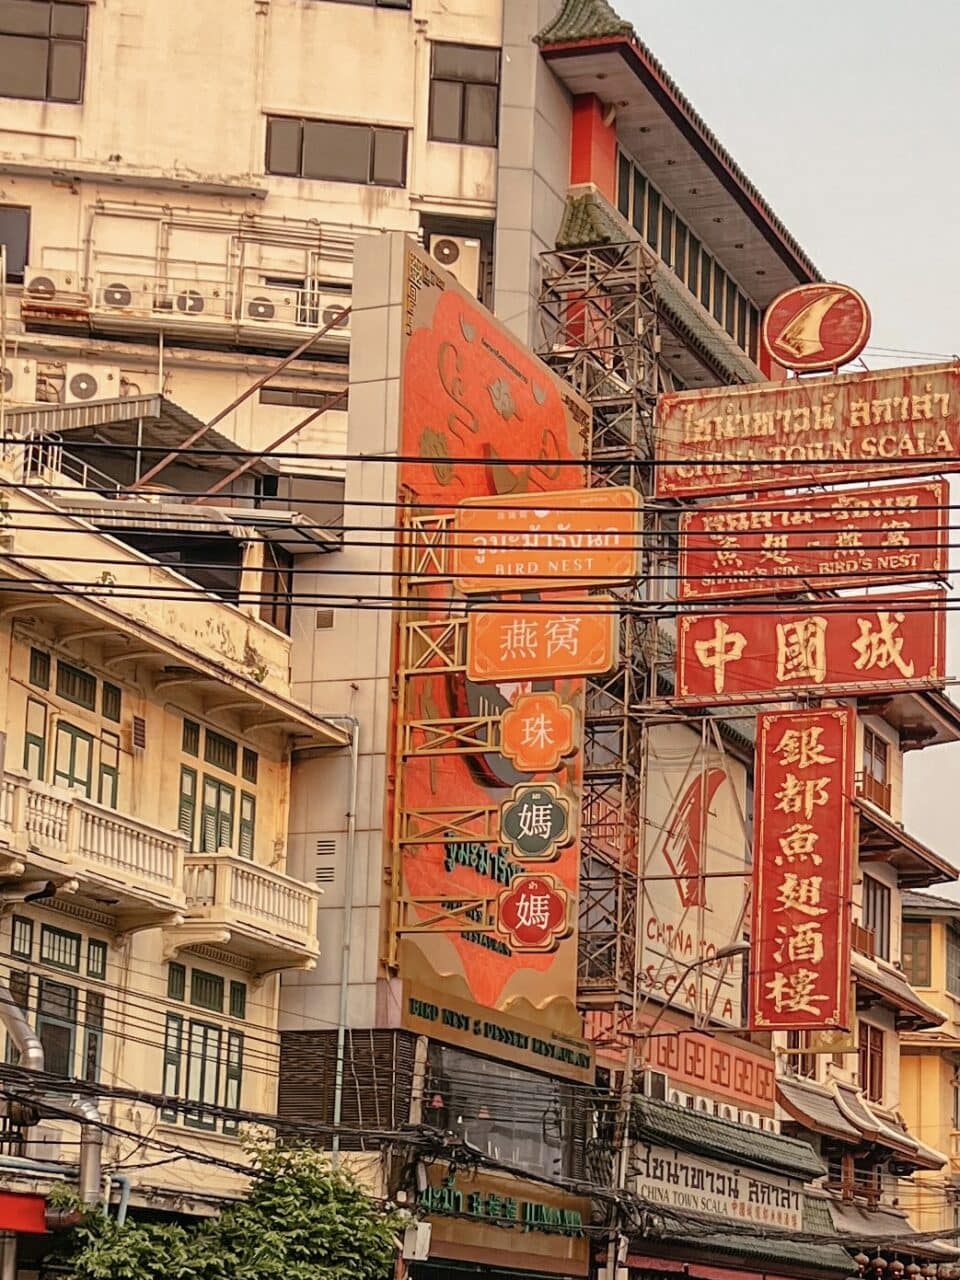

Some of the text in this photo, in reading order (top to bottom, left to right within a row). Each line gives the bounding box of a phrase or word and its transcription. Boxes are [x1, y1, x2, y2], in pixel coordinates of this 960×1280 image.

[768, 439, 852, 466] TOWN
[861, 430, 954, 458] SCALA
[495, 558, 595, 576] BIRD NEST
[819, 558, 872, 576] BIRD'S
[878, 553, 920, 570] NEST
[694, 607, 915, 694] 中國城
[521, 713, 555, 749] 珠
[518, 803, 553, 839] 媽
[515, 893, 551, 930] 媽
[640, 1184, 728, 1215] CHINA TOWN SCALA
